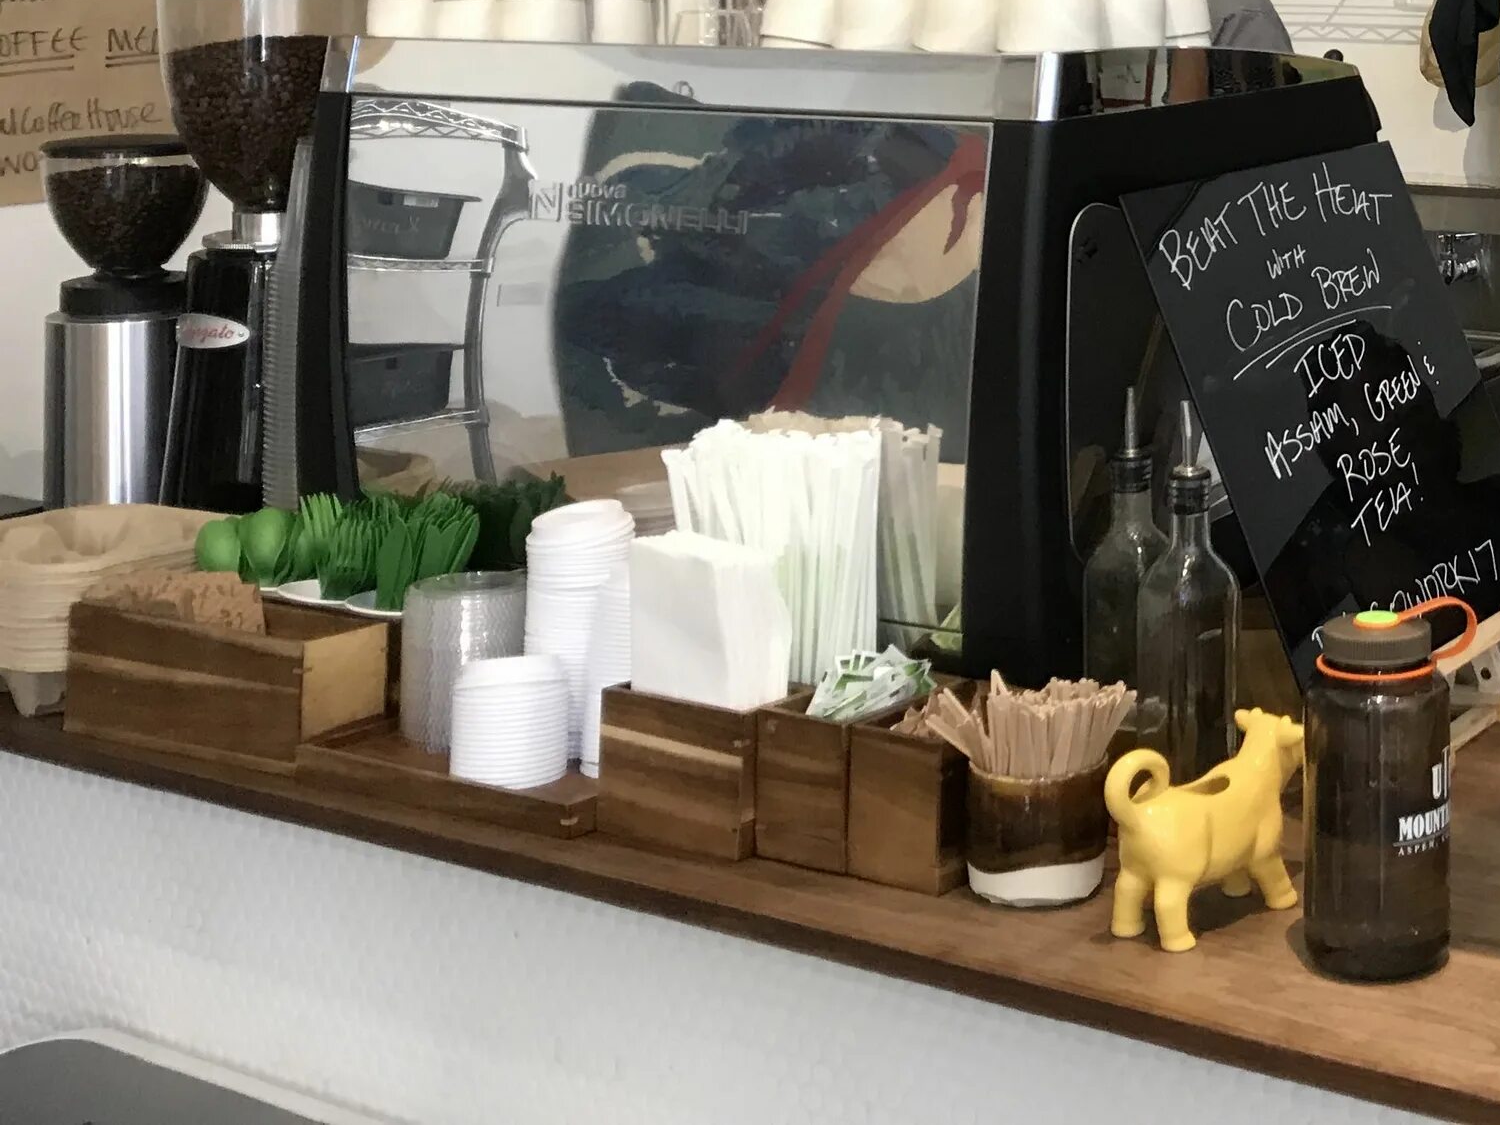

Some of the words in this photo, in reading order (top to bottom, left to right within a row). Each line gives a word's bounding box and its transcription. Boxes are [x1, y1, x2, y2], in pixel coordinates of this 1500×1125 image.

[1158, 200, 1238, 291] BEAT
[1236, 181, 1307, 237] THE
[1312, 161, 1393, 225] HEAT
[1266, 243, 1307, 279] WITH
[1226, 292, 1304, 353] COLD
[1310, 247, 1381, 309] BREW
[1293, 333, 1366, 398] ICED
[1264, 402, 1360, 479] ASSAM,
[1363, 354, 1422, 422] GREEN
[1336, 427, 1412, 502] ROSE
[1350, 461, 1425, 547] TEA!
